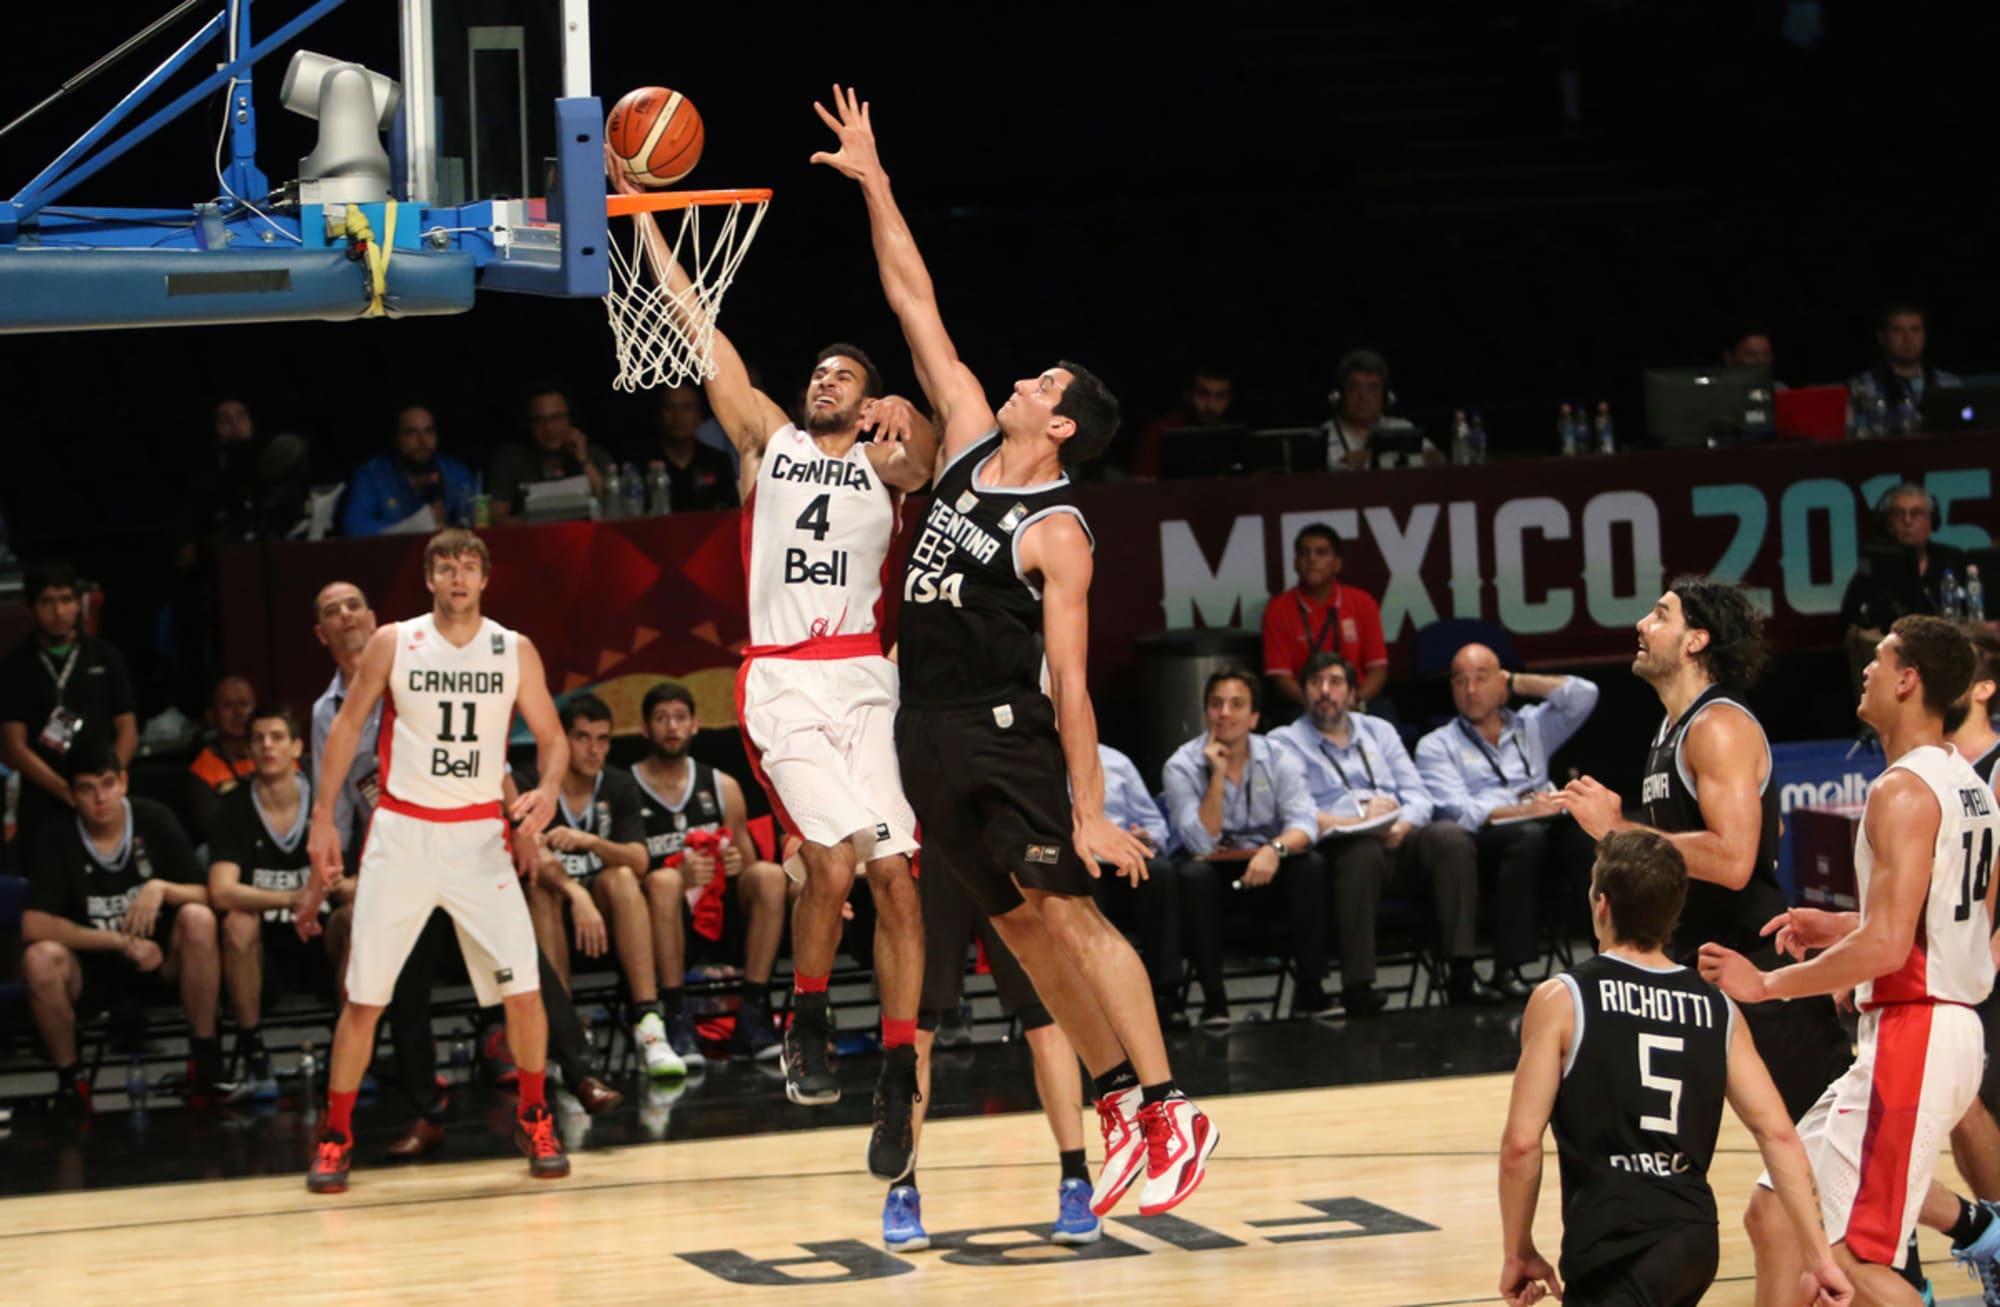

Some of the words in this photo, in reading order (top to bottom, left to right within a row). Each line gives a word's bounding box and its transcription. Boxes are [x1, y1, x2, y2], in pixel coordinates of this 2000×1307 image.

[796, 493, 831, 541] 4
[784, 548, 848, 587] Bell
[408, 670, 504, 694] CANADA
[437, 701, 478, 742] 11
[431, 748, 480, 778] Bell
[1599, 979, 1713, 1028] RICHOTTI
[1638, 1032, 1684, 1135] 5
